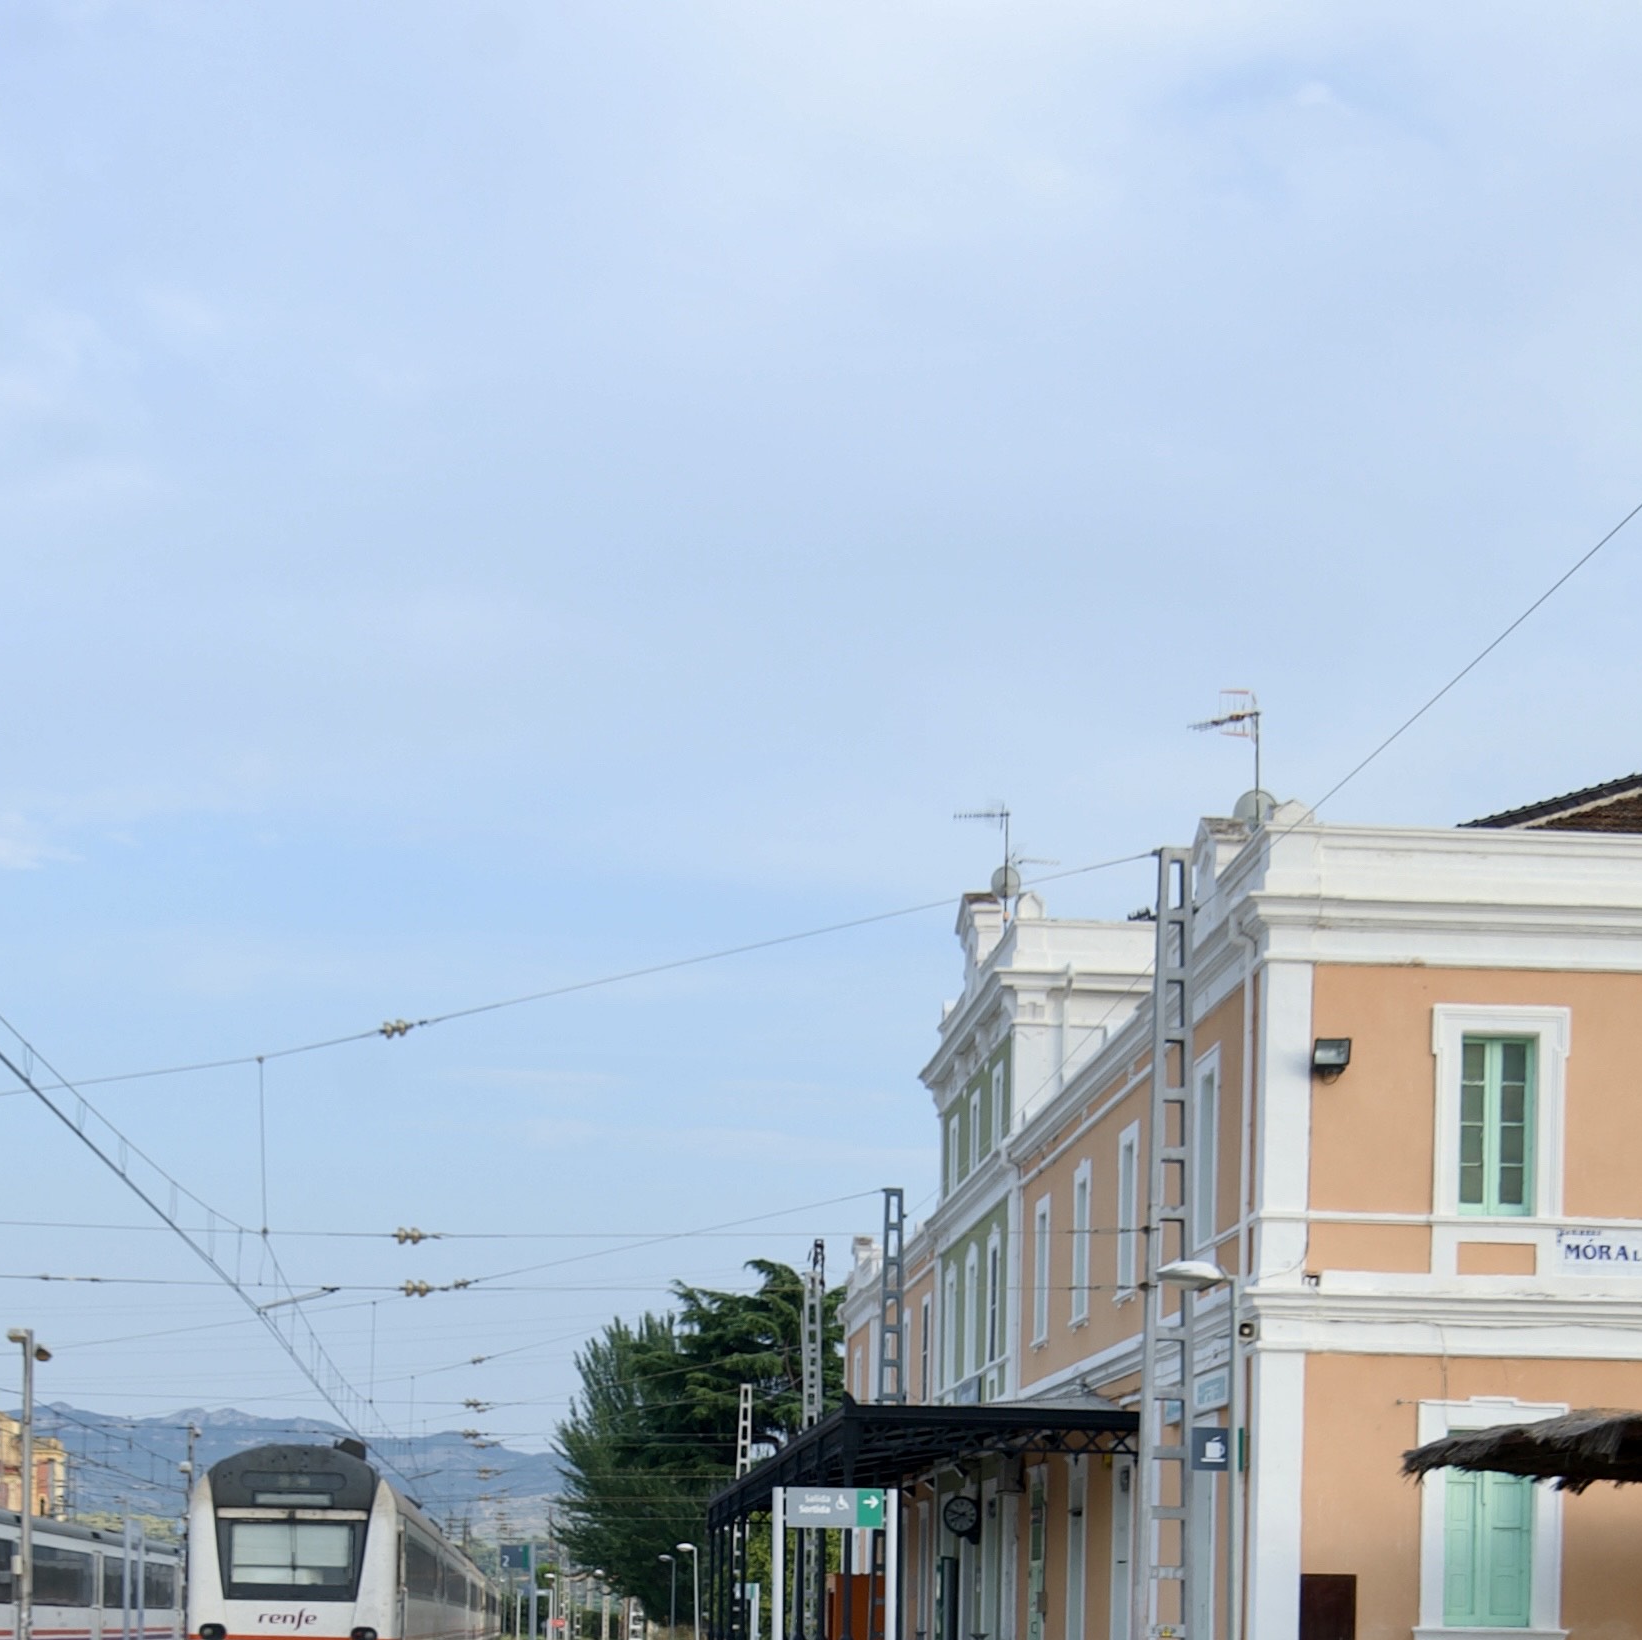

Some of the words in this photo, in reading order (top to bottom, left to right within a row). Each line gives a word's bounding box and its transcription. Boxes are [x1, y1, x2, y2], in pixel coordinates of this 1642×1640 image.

[1564, 1238, 1629, 1262] MÓRA
[502, 1554, 511, 1568] 2
[257, 1607, 318, 1631] renfe
